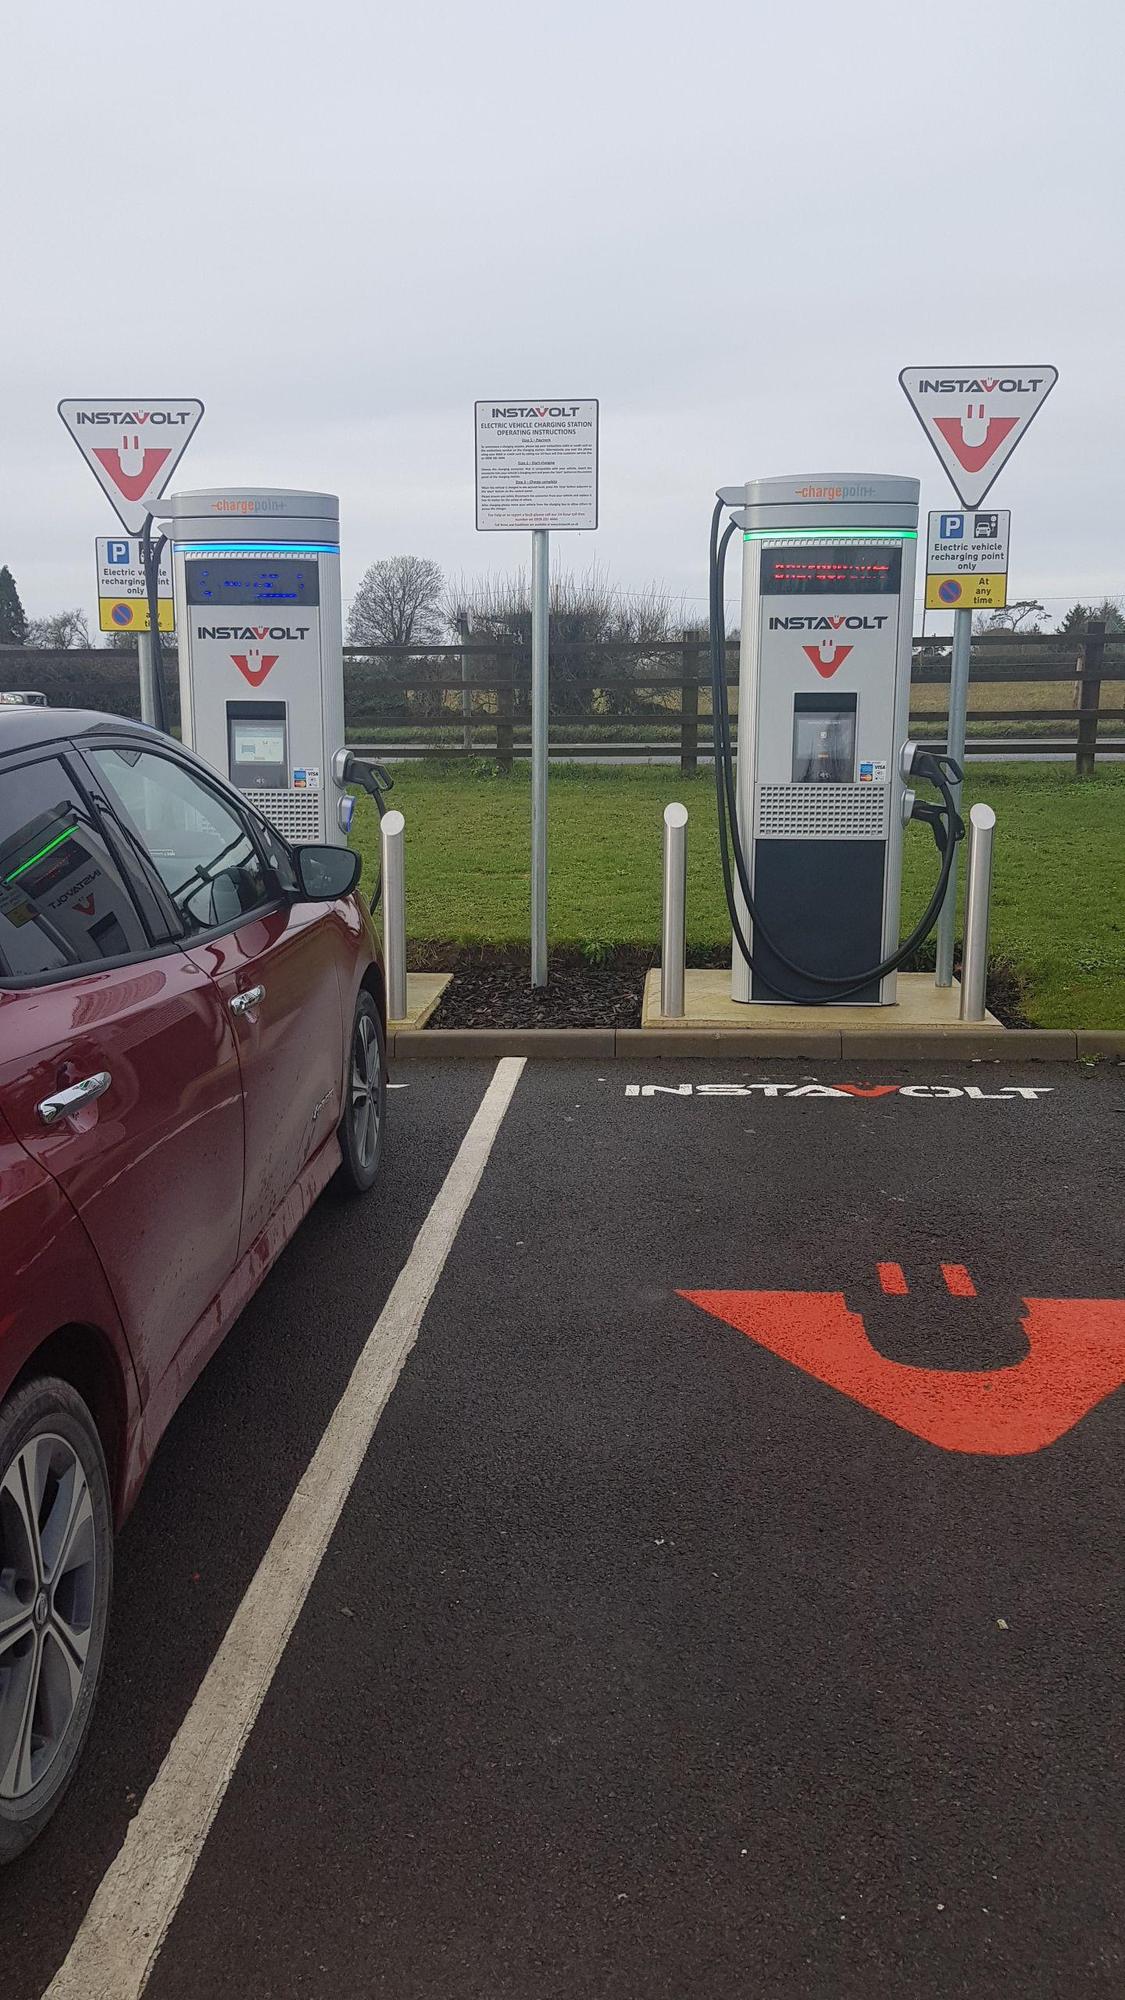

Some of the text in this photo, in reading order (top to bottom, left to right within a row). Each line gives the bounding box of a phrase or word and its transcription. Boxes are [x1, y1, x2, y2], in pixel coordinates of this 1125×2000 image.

[918, 377, 1044, 393] INSTAVOLT
[491, 407, 580, 418] INSTAVOLT
[76, 410, 191, 425] INSTAVOLT
[934, 543, 1003, 551] Electric vehicle
[931, 552, 1004, 561] recharging point
[957, 562, 977, 571] only
[103, 568, 136, 576] Electric
[101, 577, 146, 587] recharging
[978, 577, 989, 585] At
[126, 587, 145, 596] only
[975, 587, 992, 596] any
[973, 596, 993, 604] time
[768, 614, 889, 630] INSTAVOLT
[197, 626, 311, 641] INSTAVOLT
[624, 1082, 1056, 1100] INSTAVOLT
